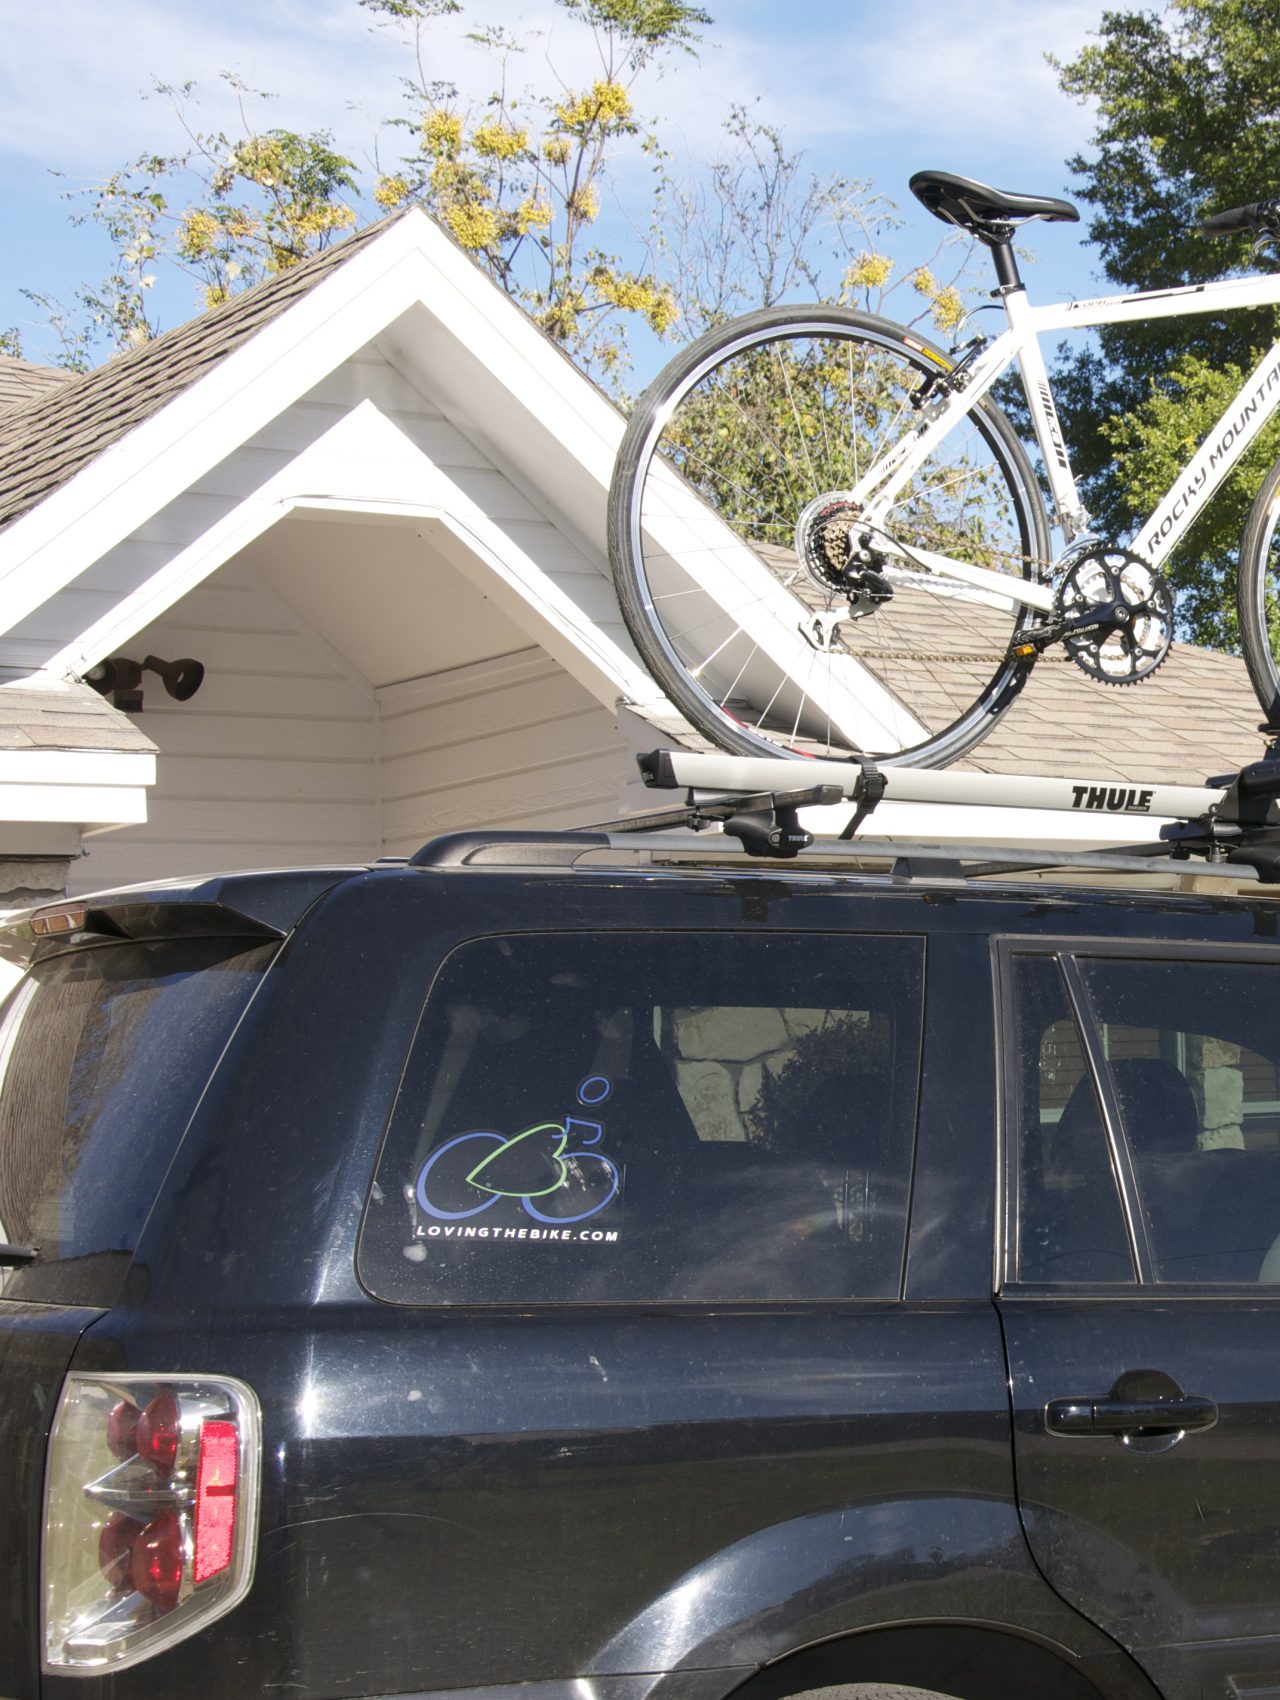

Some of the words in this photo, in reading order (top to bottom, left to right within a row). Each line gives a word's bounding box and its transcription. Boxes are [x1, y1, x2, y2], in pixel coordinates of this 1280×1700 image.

[1147, 471, 1207, 556] ROCKY
[1072, 786, 1153, 812] THULE
[788, 834, 809, 842] THULE
[417, 1225, 618, 1242] LOVINGTHEBIKE.COM
